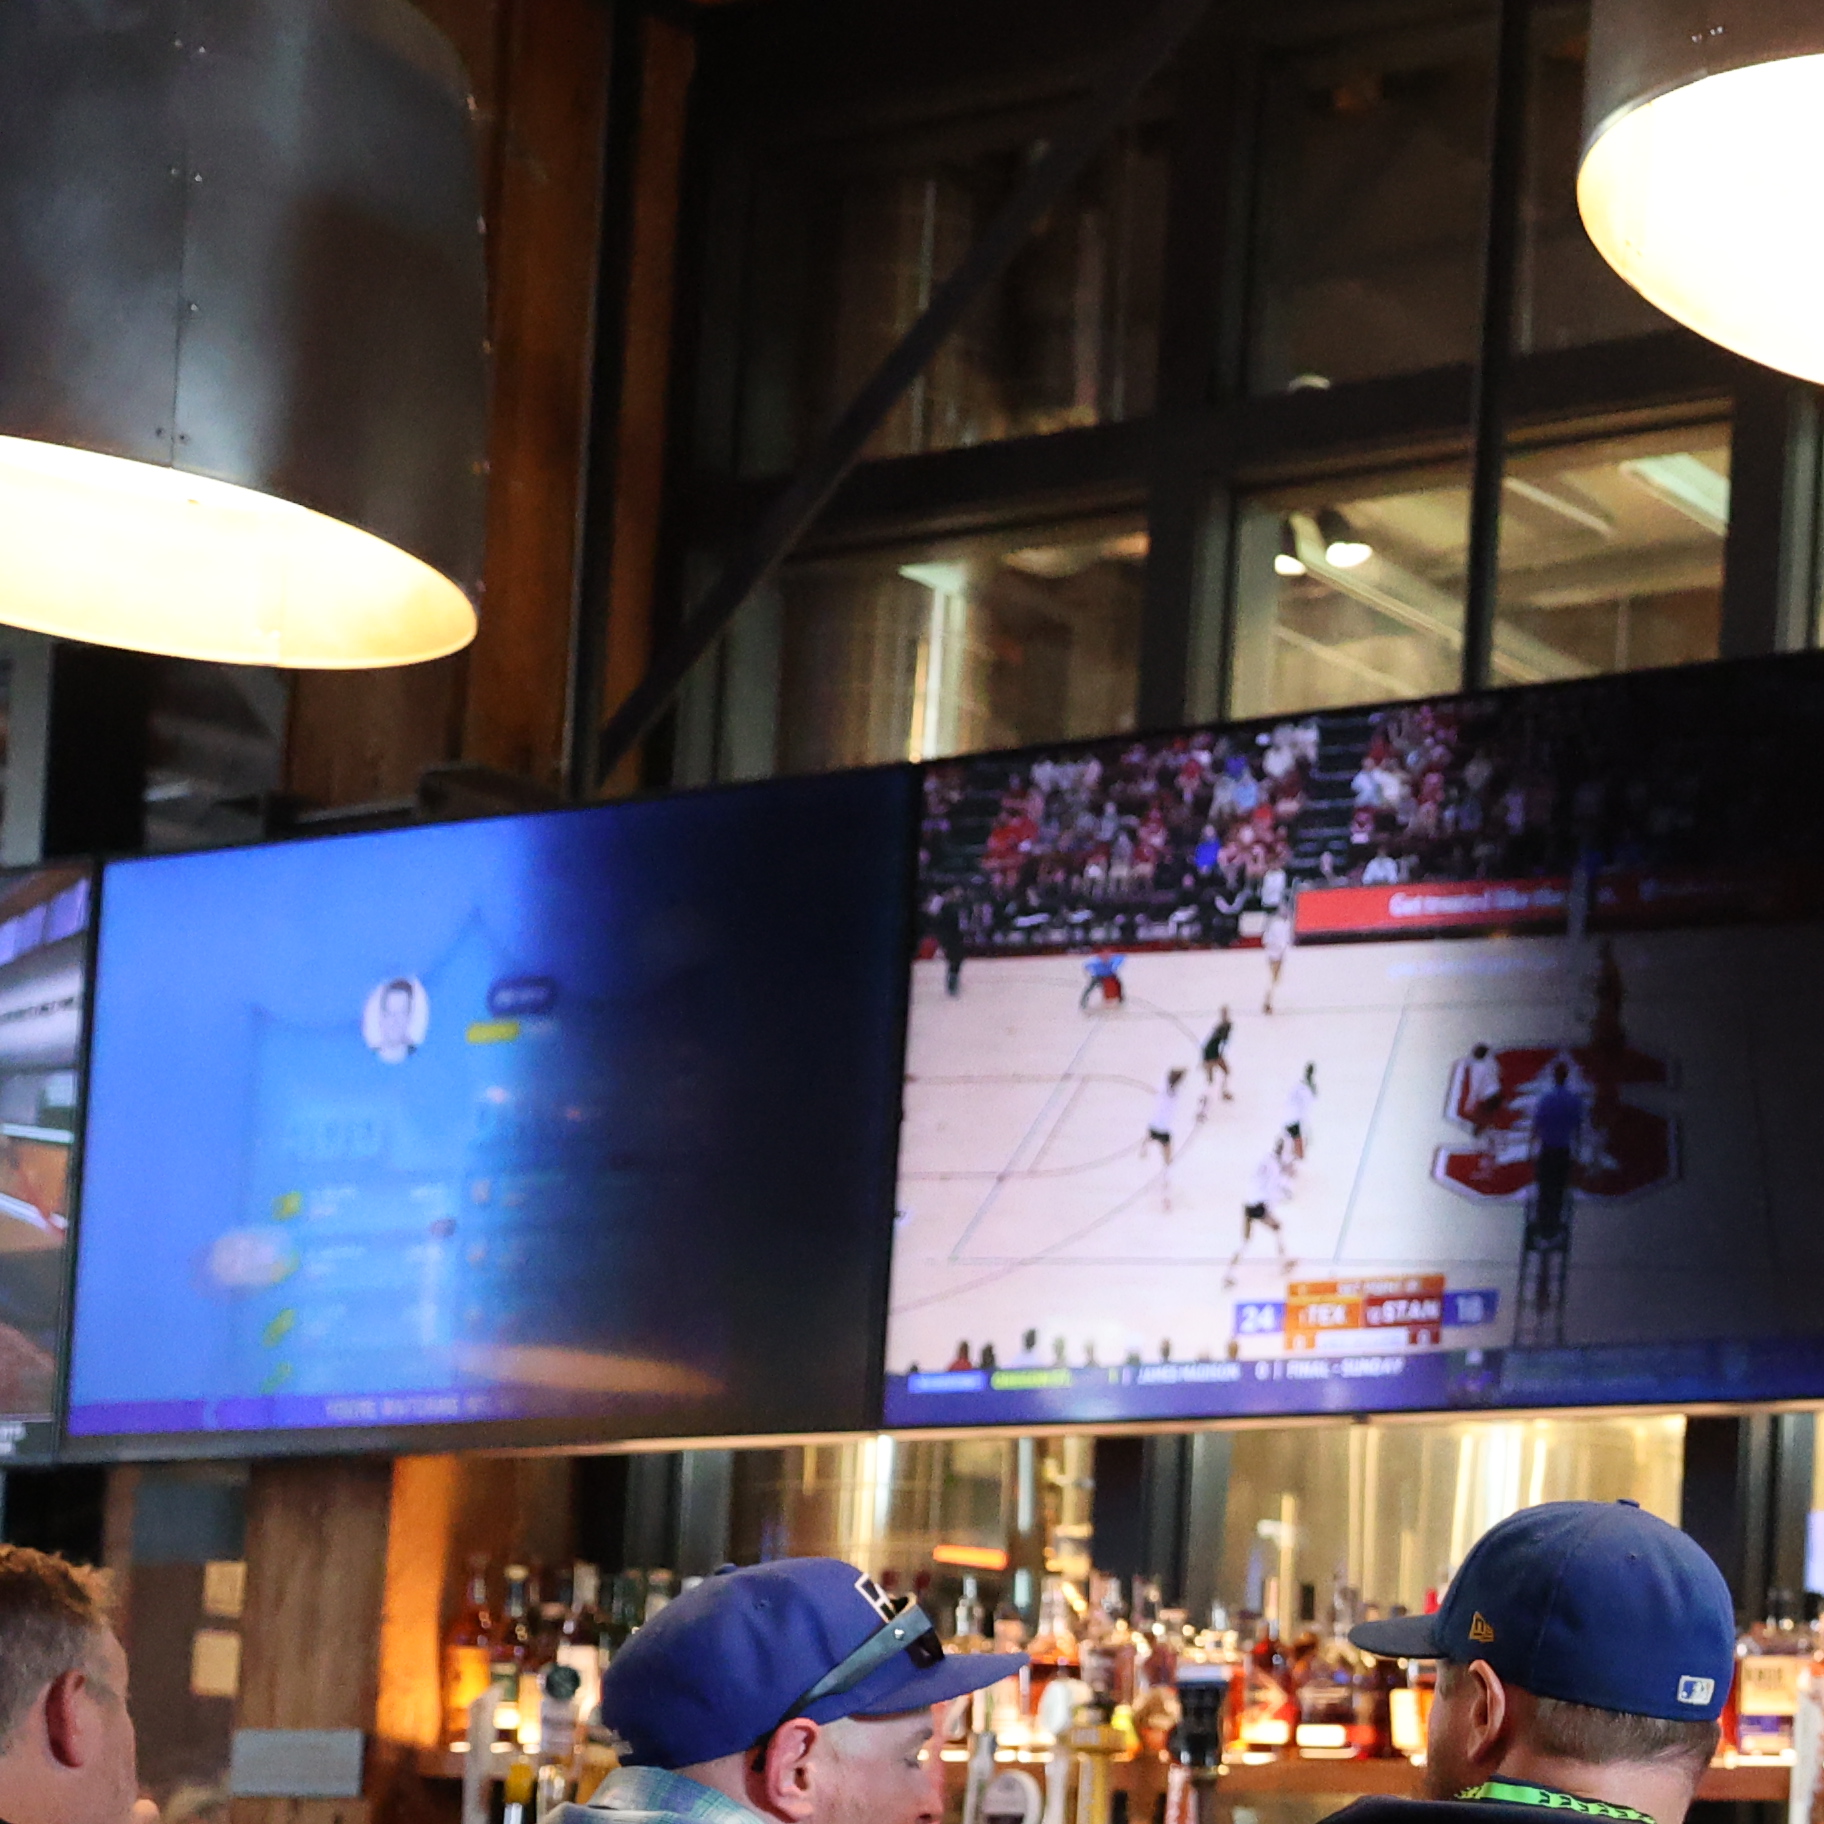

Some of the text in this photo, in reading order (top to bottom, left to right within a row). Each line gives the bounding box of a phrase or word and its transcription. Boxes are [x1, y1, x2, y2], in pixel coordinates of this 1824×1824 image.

[1240, 1303, 1276, 1333] 24
[1307, 1302, 1348, 1326] TEX
[1383, 1298, 1440, 1324] STAN
